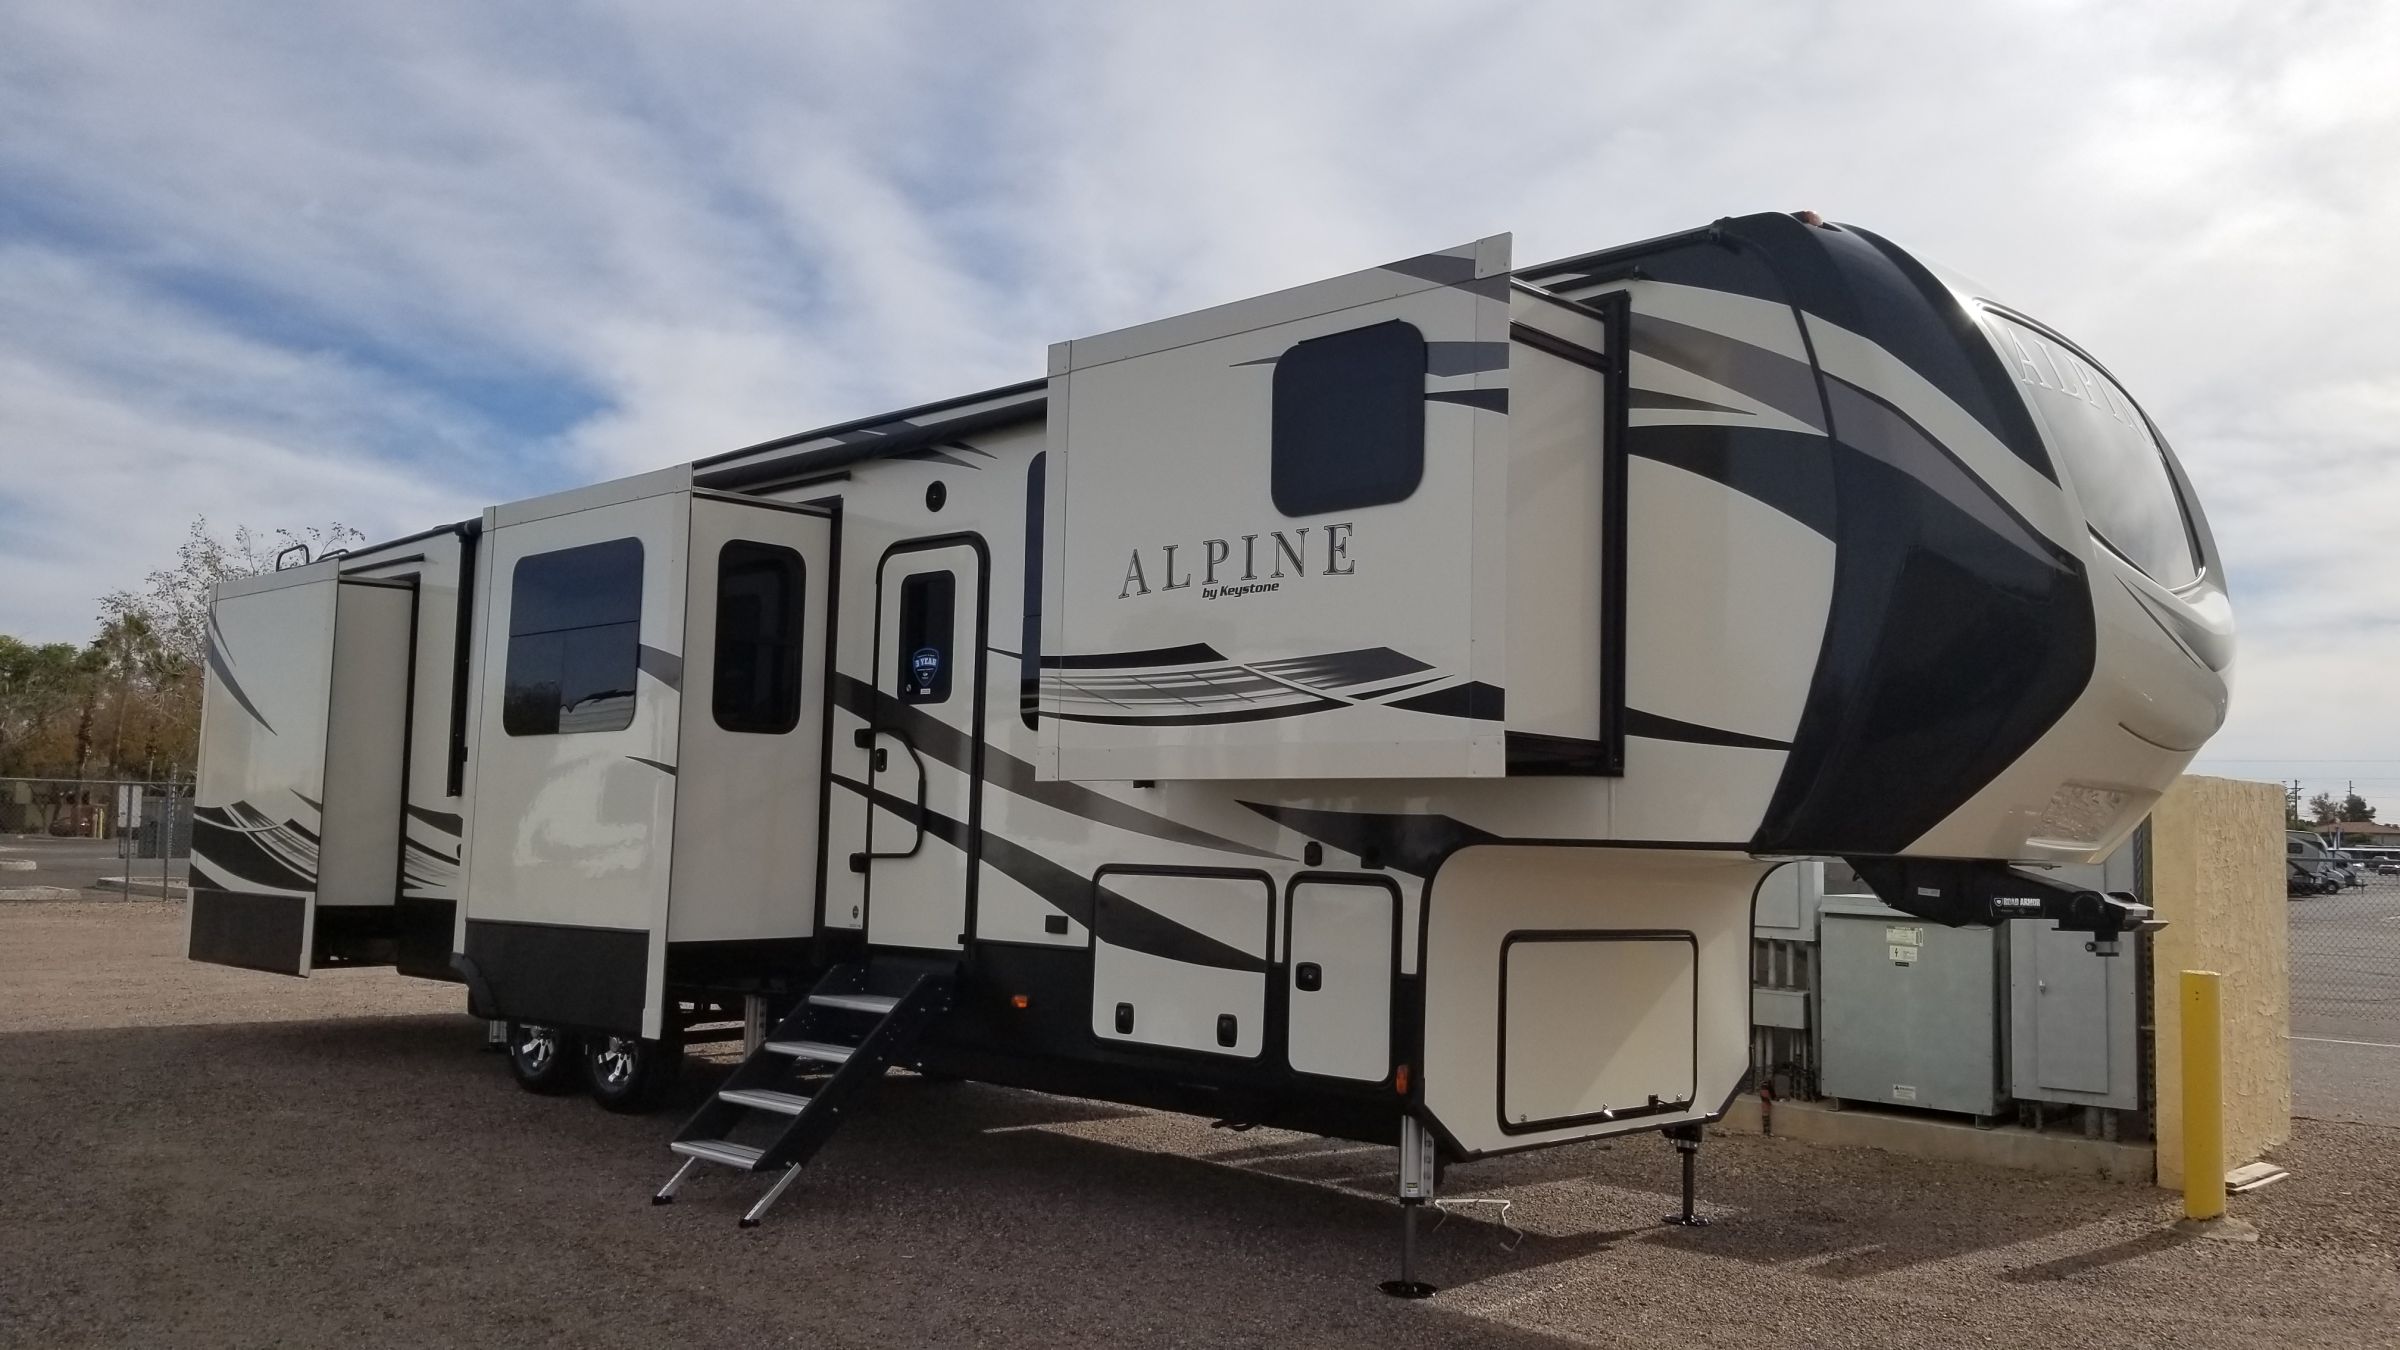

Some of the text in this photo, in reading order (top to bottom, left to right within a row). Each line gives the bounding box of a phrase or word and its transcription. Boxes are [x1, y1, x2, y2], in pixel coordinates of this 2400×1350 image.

[1118, 522, 1356, 599] ALPINE
[1202, 583, 1279, 600] by Keystone
[2020, 897, 2041, 907] ARMOR
